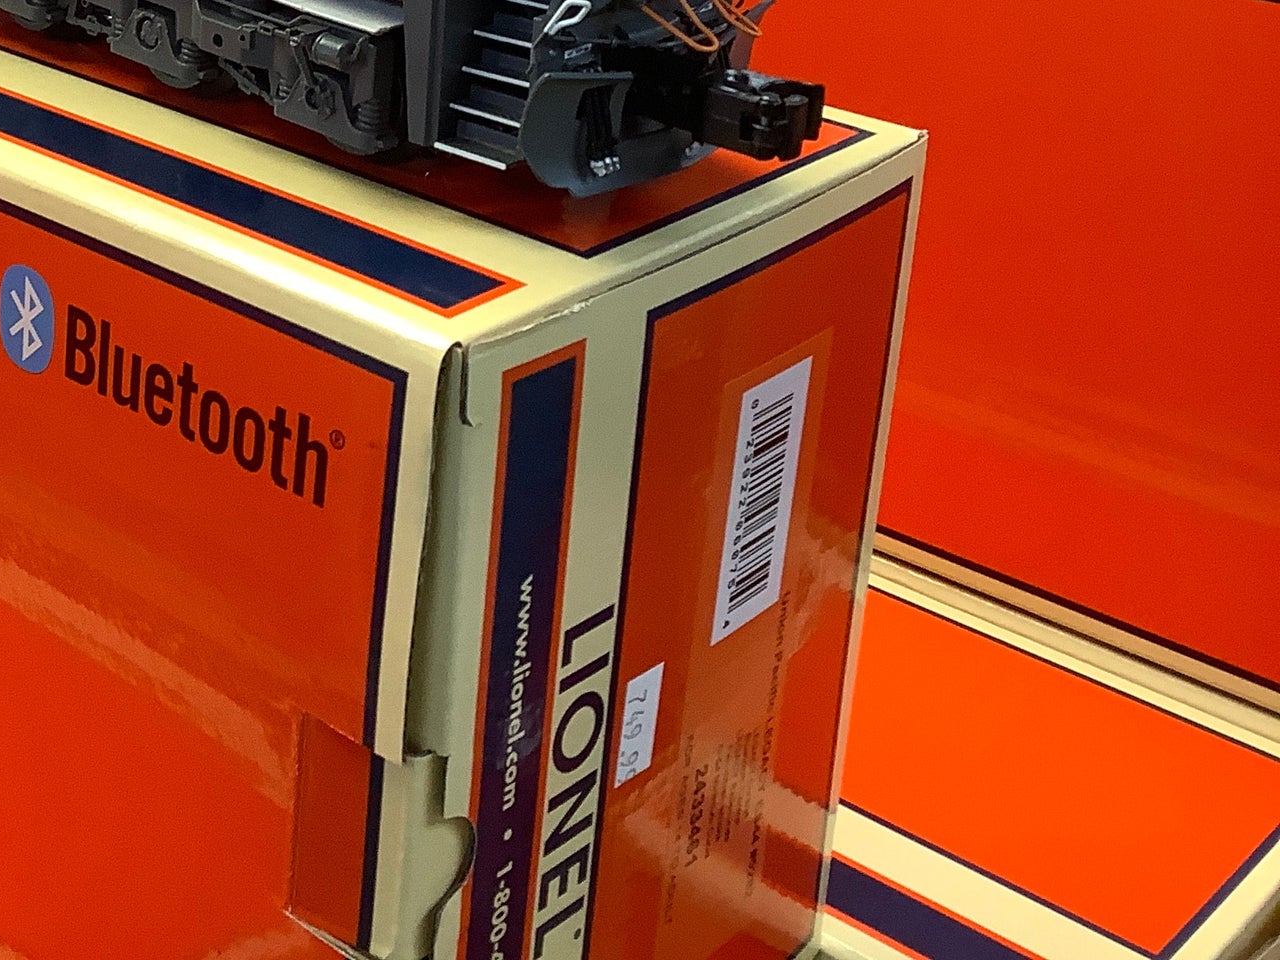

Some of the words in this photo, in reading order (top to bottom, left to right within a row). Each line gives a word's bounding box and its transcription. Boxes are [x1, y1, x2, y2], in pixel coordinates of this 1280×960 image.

[64, 304, 329, 509] Bluetooth
[502, 574, 533, 812] www.lionel.com
[532, 603, 617, 960] LIONEL
